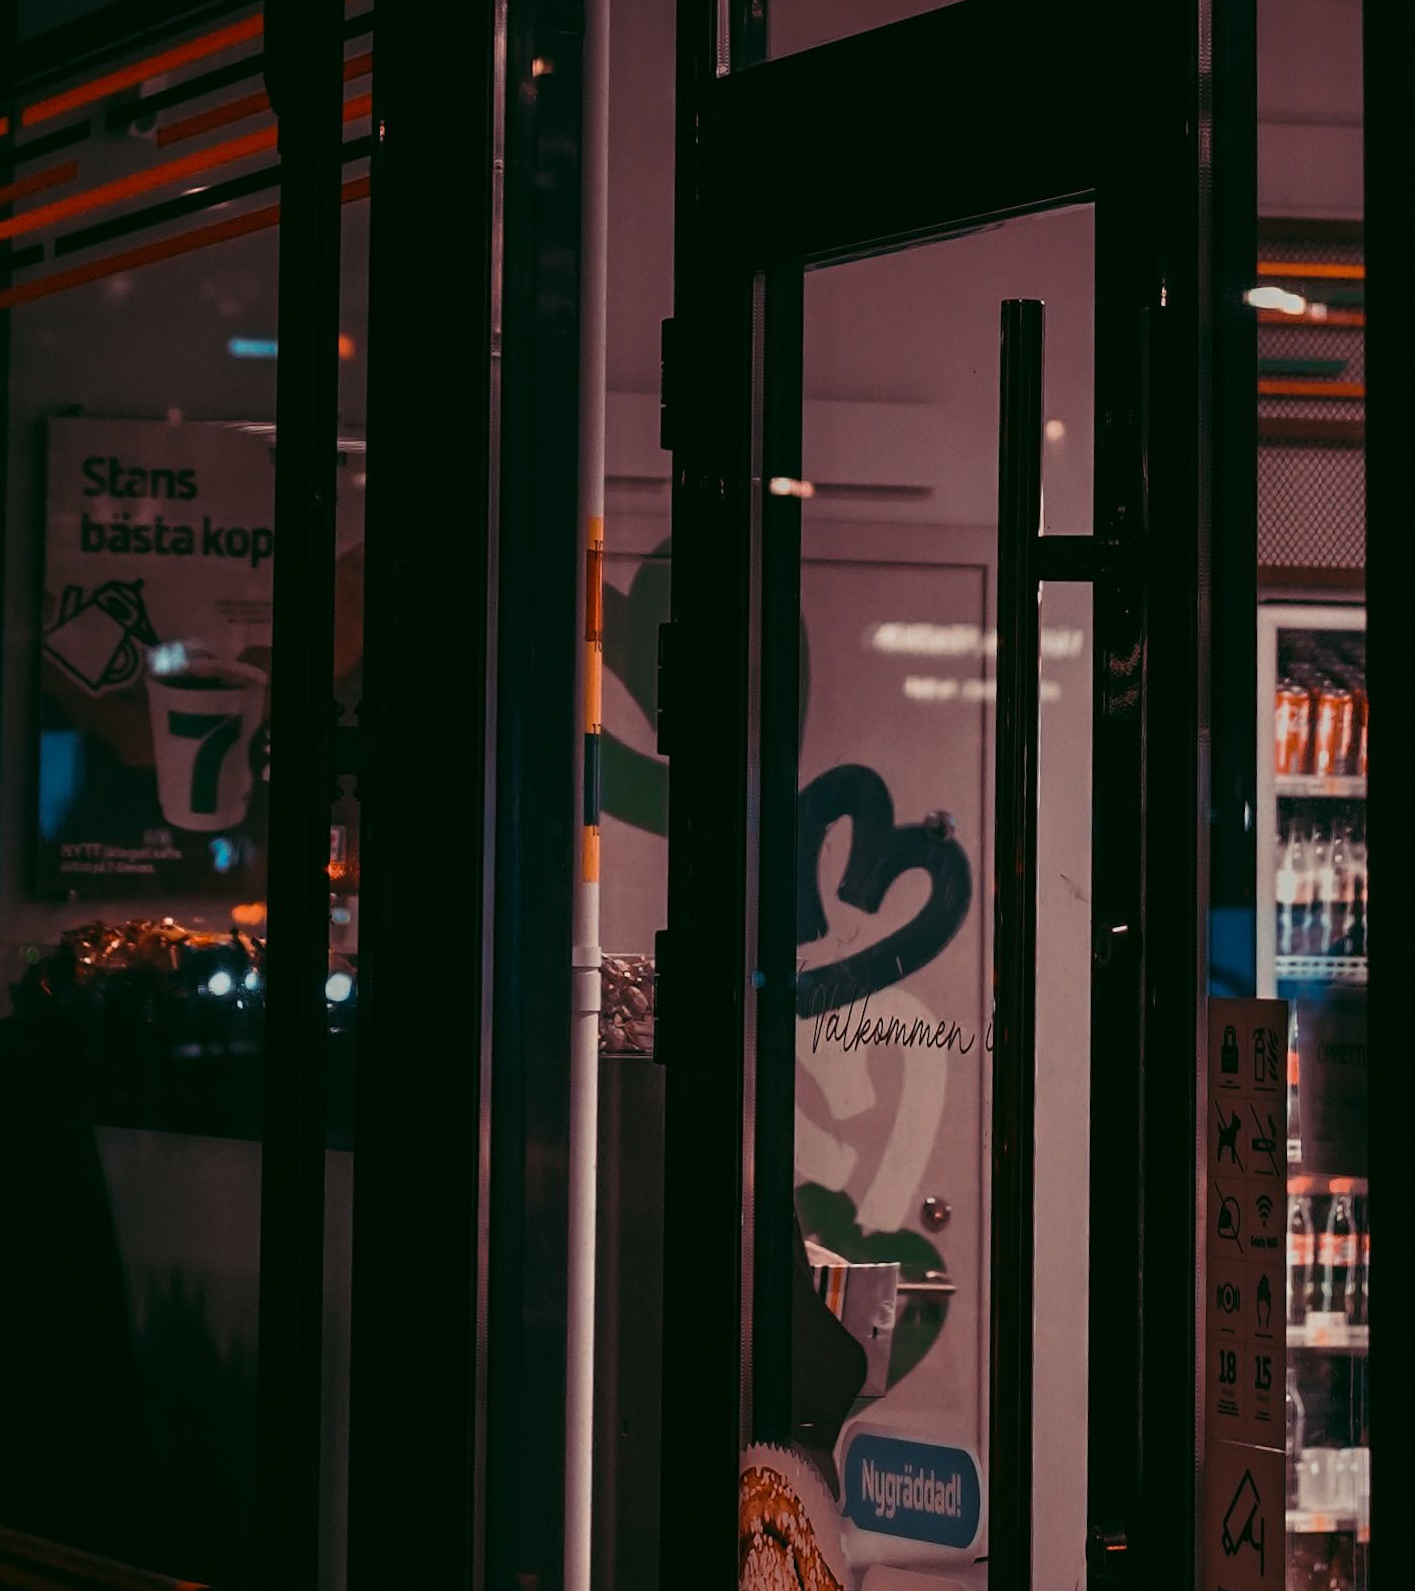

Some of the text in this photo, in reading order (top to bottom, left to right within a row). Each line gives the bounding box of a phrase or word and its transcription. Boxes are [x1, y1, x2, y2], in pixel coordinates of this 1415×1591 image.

[81, 455, 198, 500] Stans
[80, 512, 195, 556] bästa
[1218, 1349, 1272, 1391] 18 15
[861, 1458, 963, 1520] Nygräddad!
